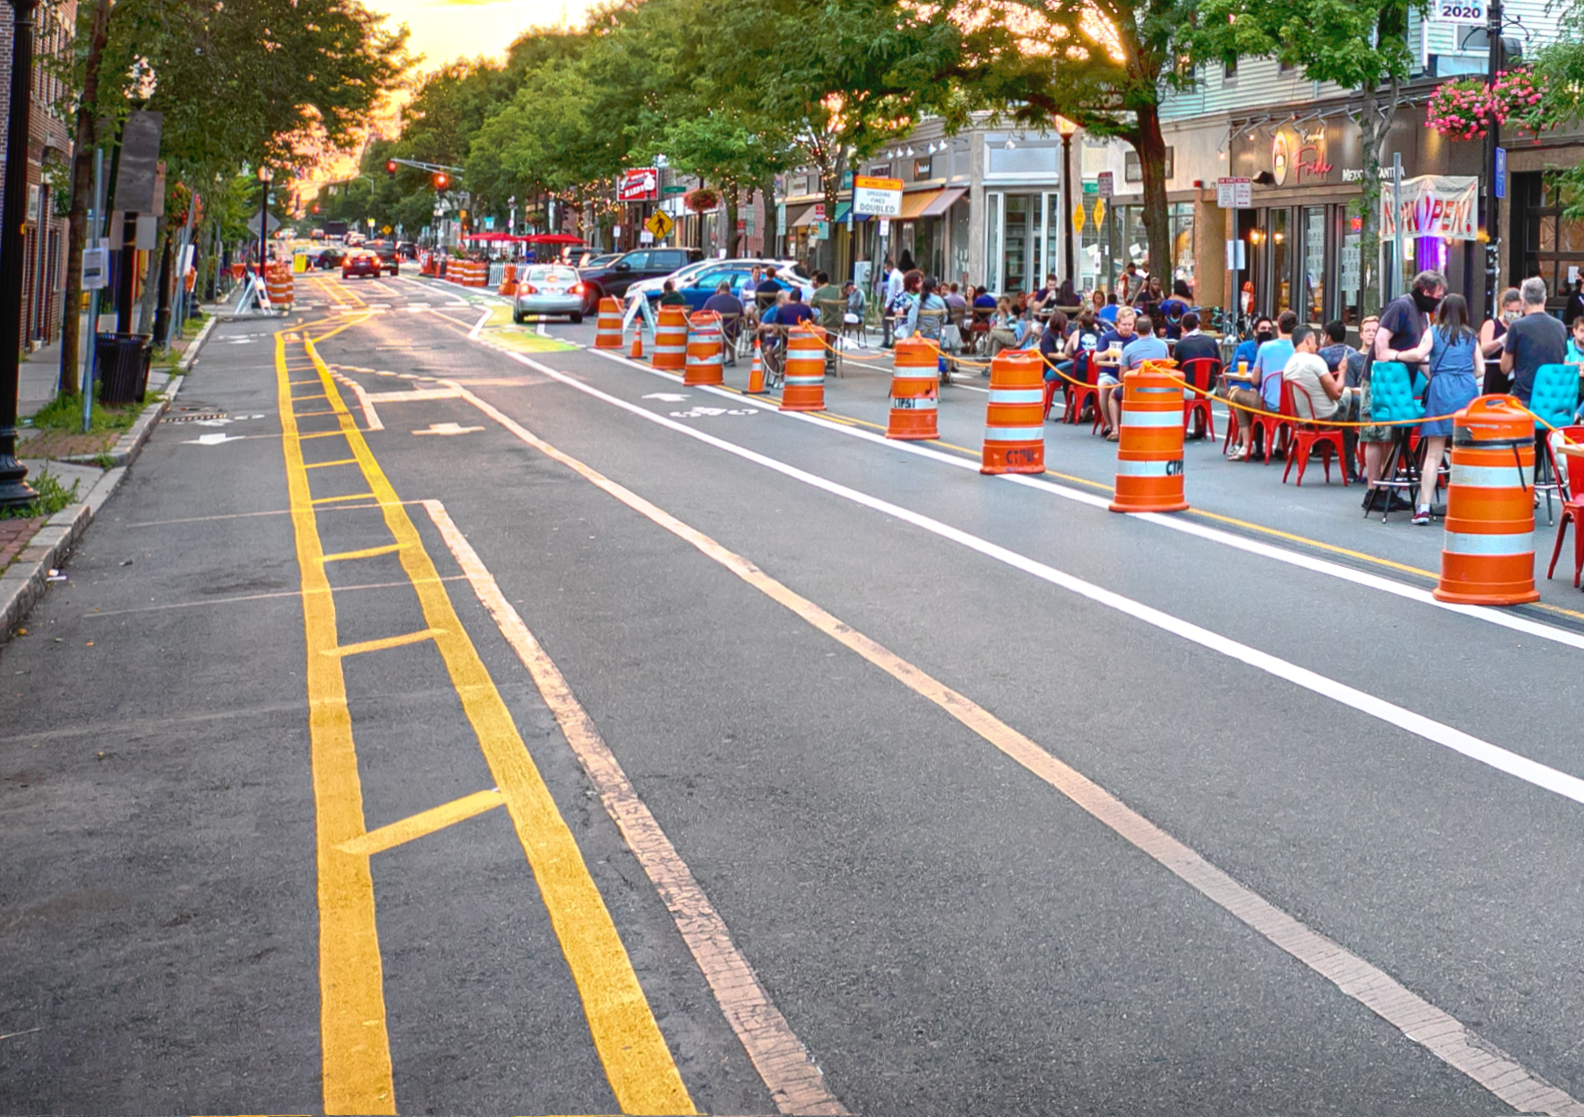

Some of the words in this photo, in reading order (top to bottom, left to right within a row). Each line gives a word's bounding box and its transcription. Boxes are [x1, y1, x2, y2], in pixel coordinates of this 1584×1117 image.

[1442, 5, 1481, 19] 2020
[866, 190, 891, 198] SPEEDING
[860, 203, 896, 214] DOUBLED
